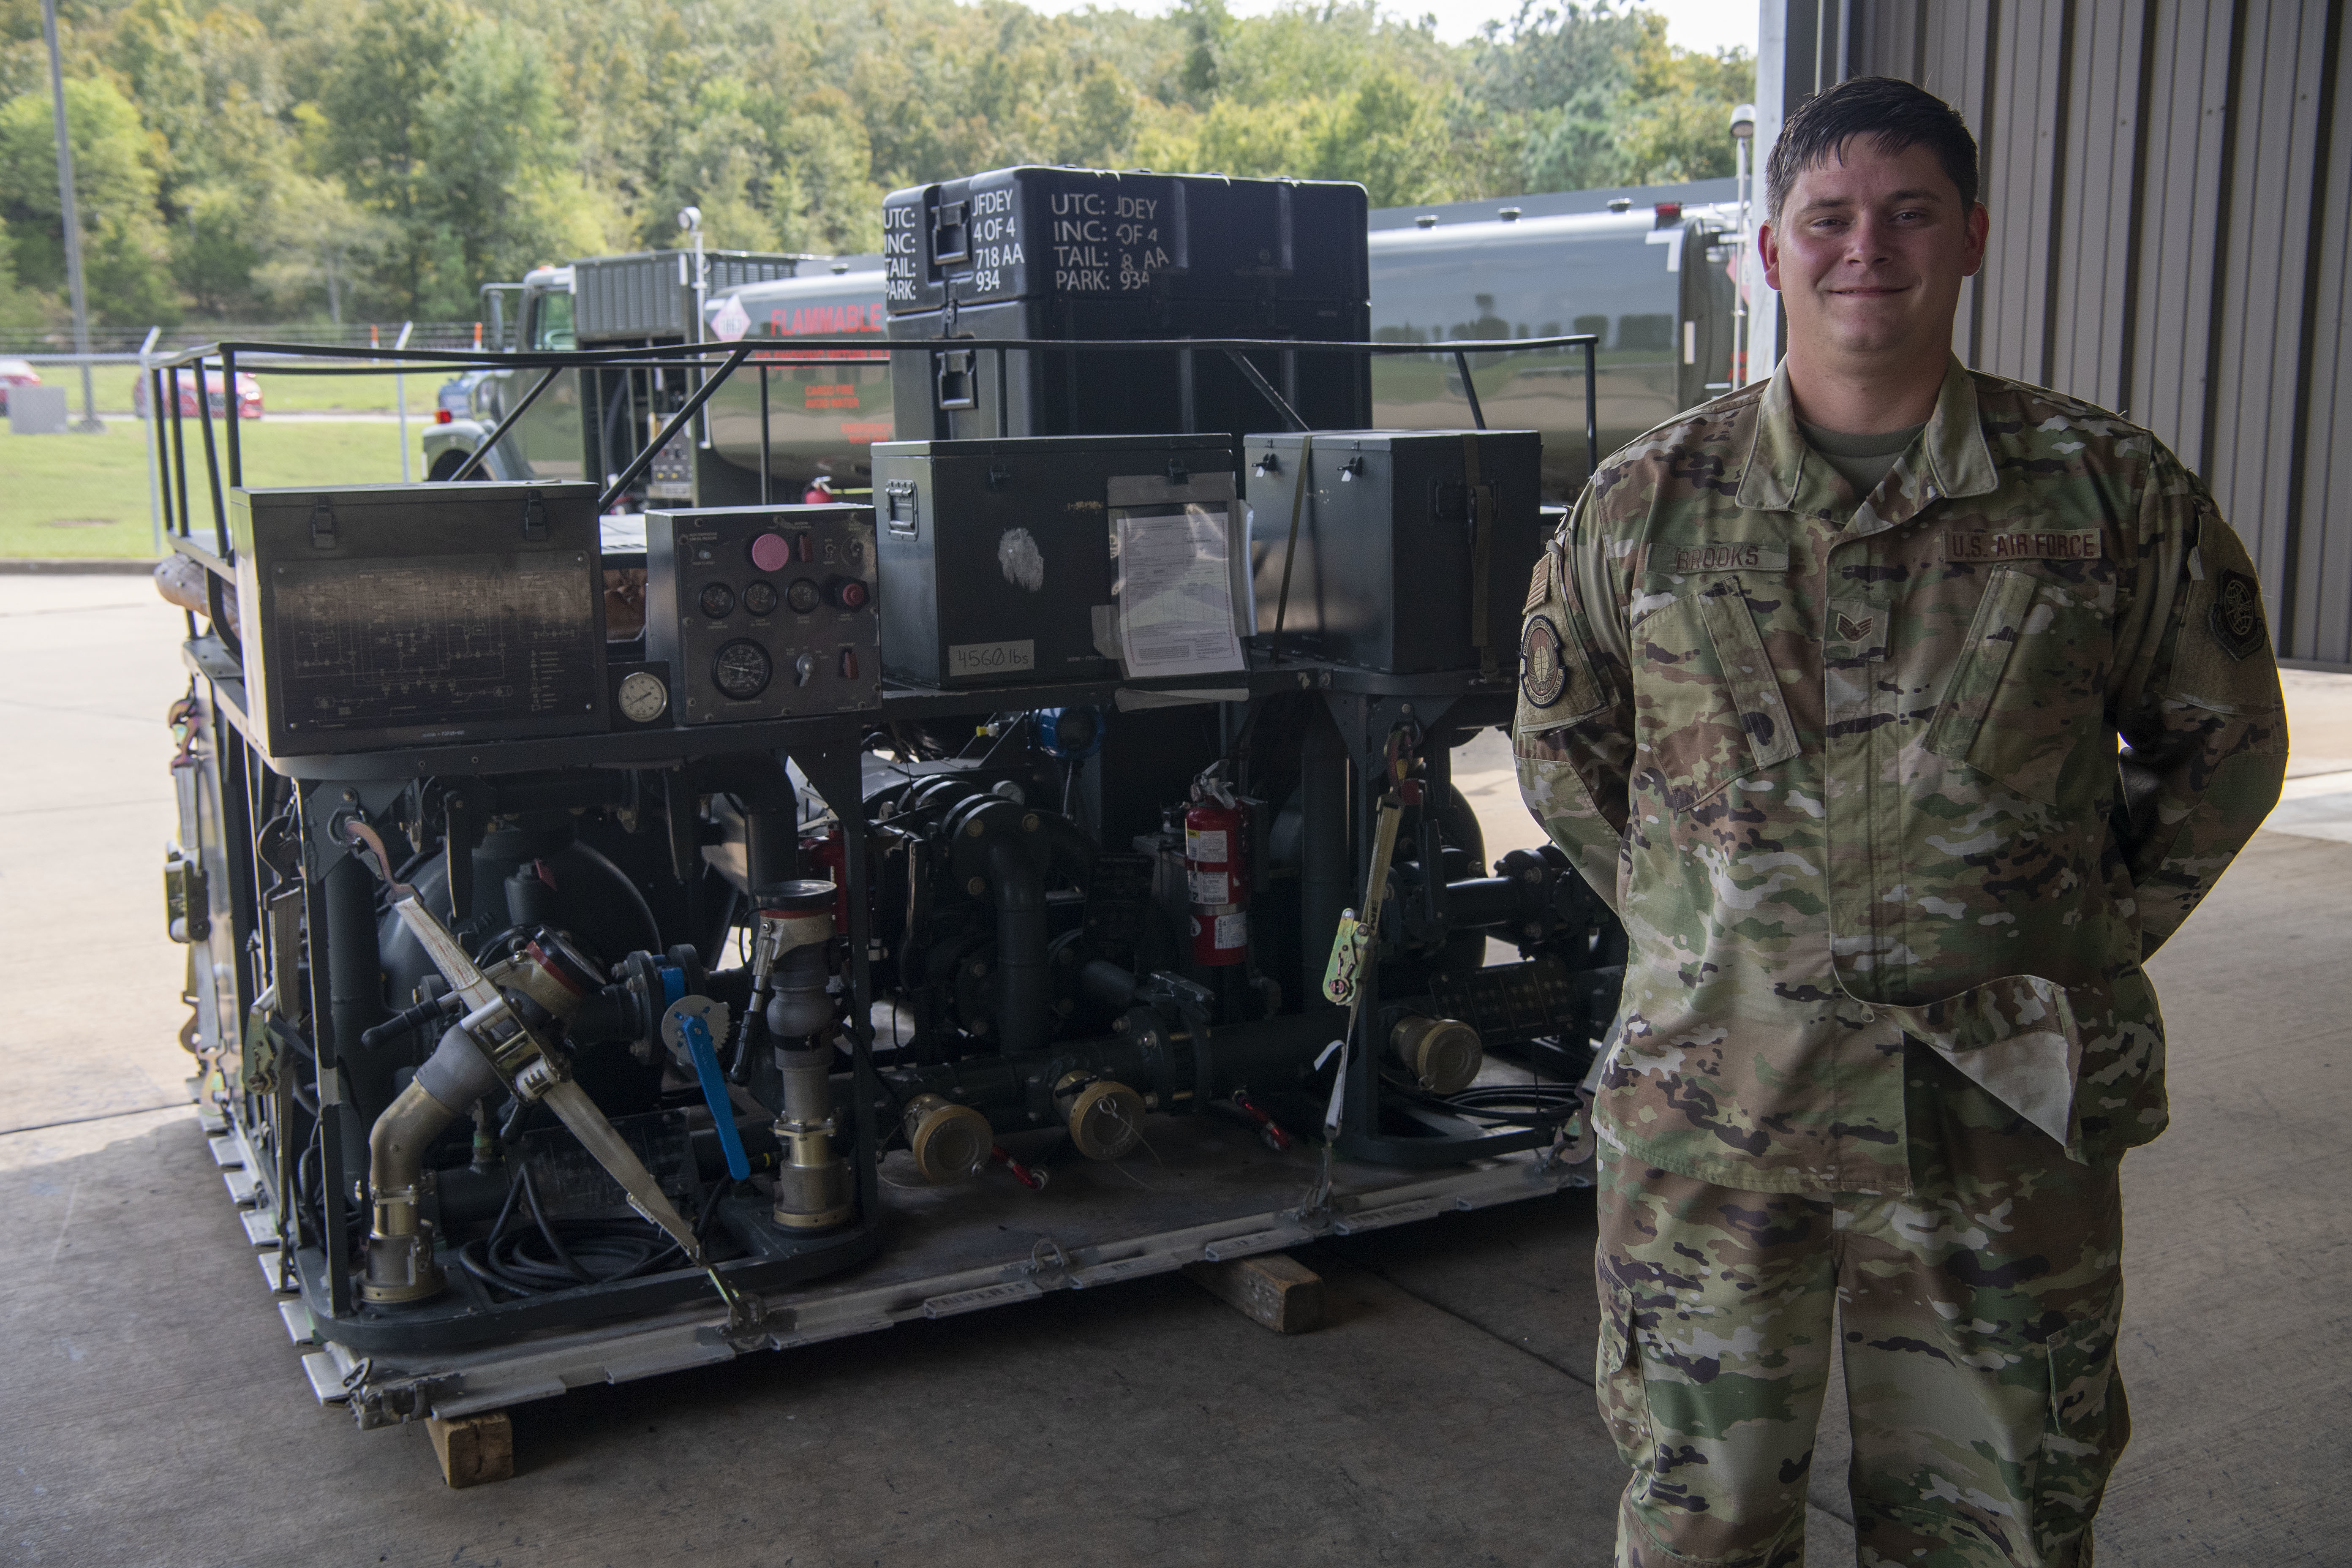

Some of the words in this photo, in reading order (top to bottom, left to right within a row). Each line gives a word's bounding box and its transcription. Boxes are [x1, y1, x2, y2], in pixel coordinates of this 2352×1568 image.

[882, 207, 915, 229] UTC:
[972, 189, 1013, 217] JFDEY
[1051, 193, 1106, 215] UTC:
[884, 232, 916, 254] INC:
[973, 222, 983, 242] 4
[984, 217, 1003, 241] OF
[1005, 216, 1016, 237] 4
[1054, 220, 1108, 242] INC:
[885, 257, 916, 278] TAIL:
[975, 246, 1000, 270] 718
[1002, 242, 1025, 266] AA
[1053, 246, 1109, 267] TAIL:
[1143, 246, 1170, 270] AA
[885, 280, 916, 301] PARK:
[976, 269, 1001, 292] 934
[1055, 269, 1111, 291] PARK:
[1119, 271, 1150, 291] 934
[770, 303, 883, 337] FLAMMABLE
[1676, 546, 1759, 570] BROOKS
[1952, 534, 1988, 558] U.S.
[1996, 532, 2028, 557] AIR
[2035, 532, 2095, 557] FORCE
